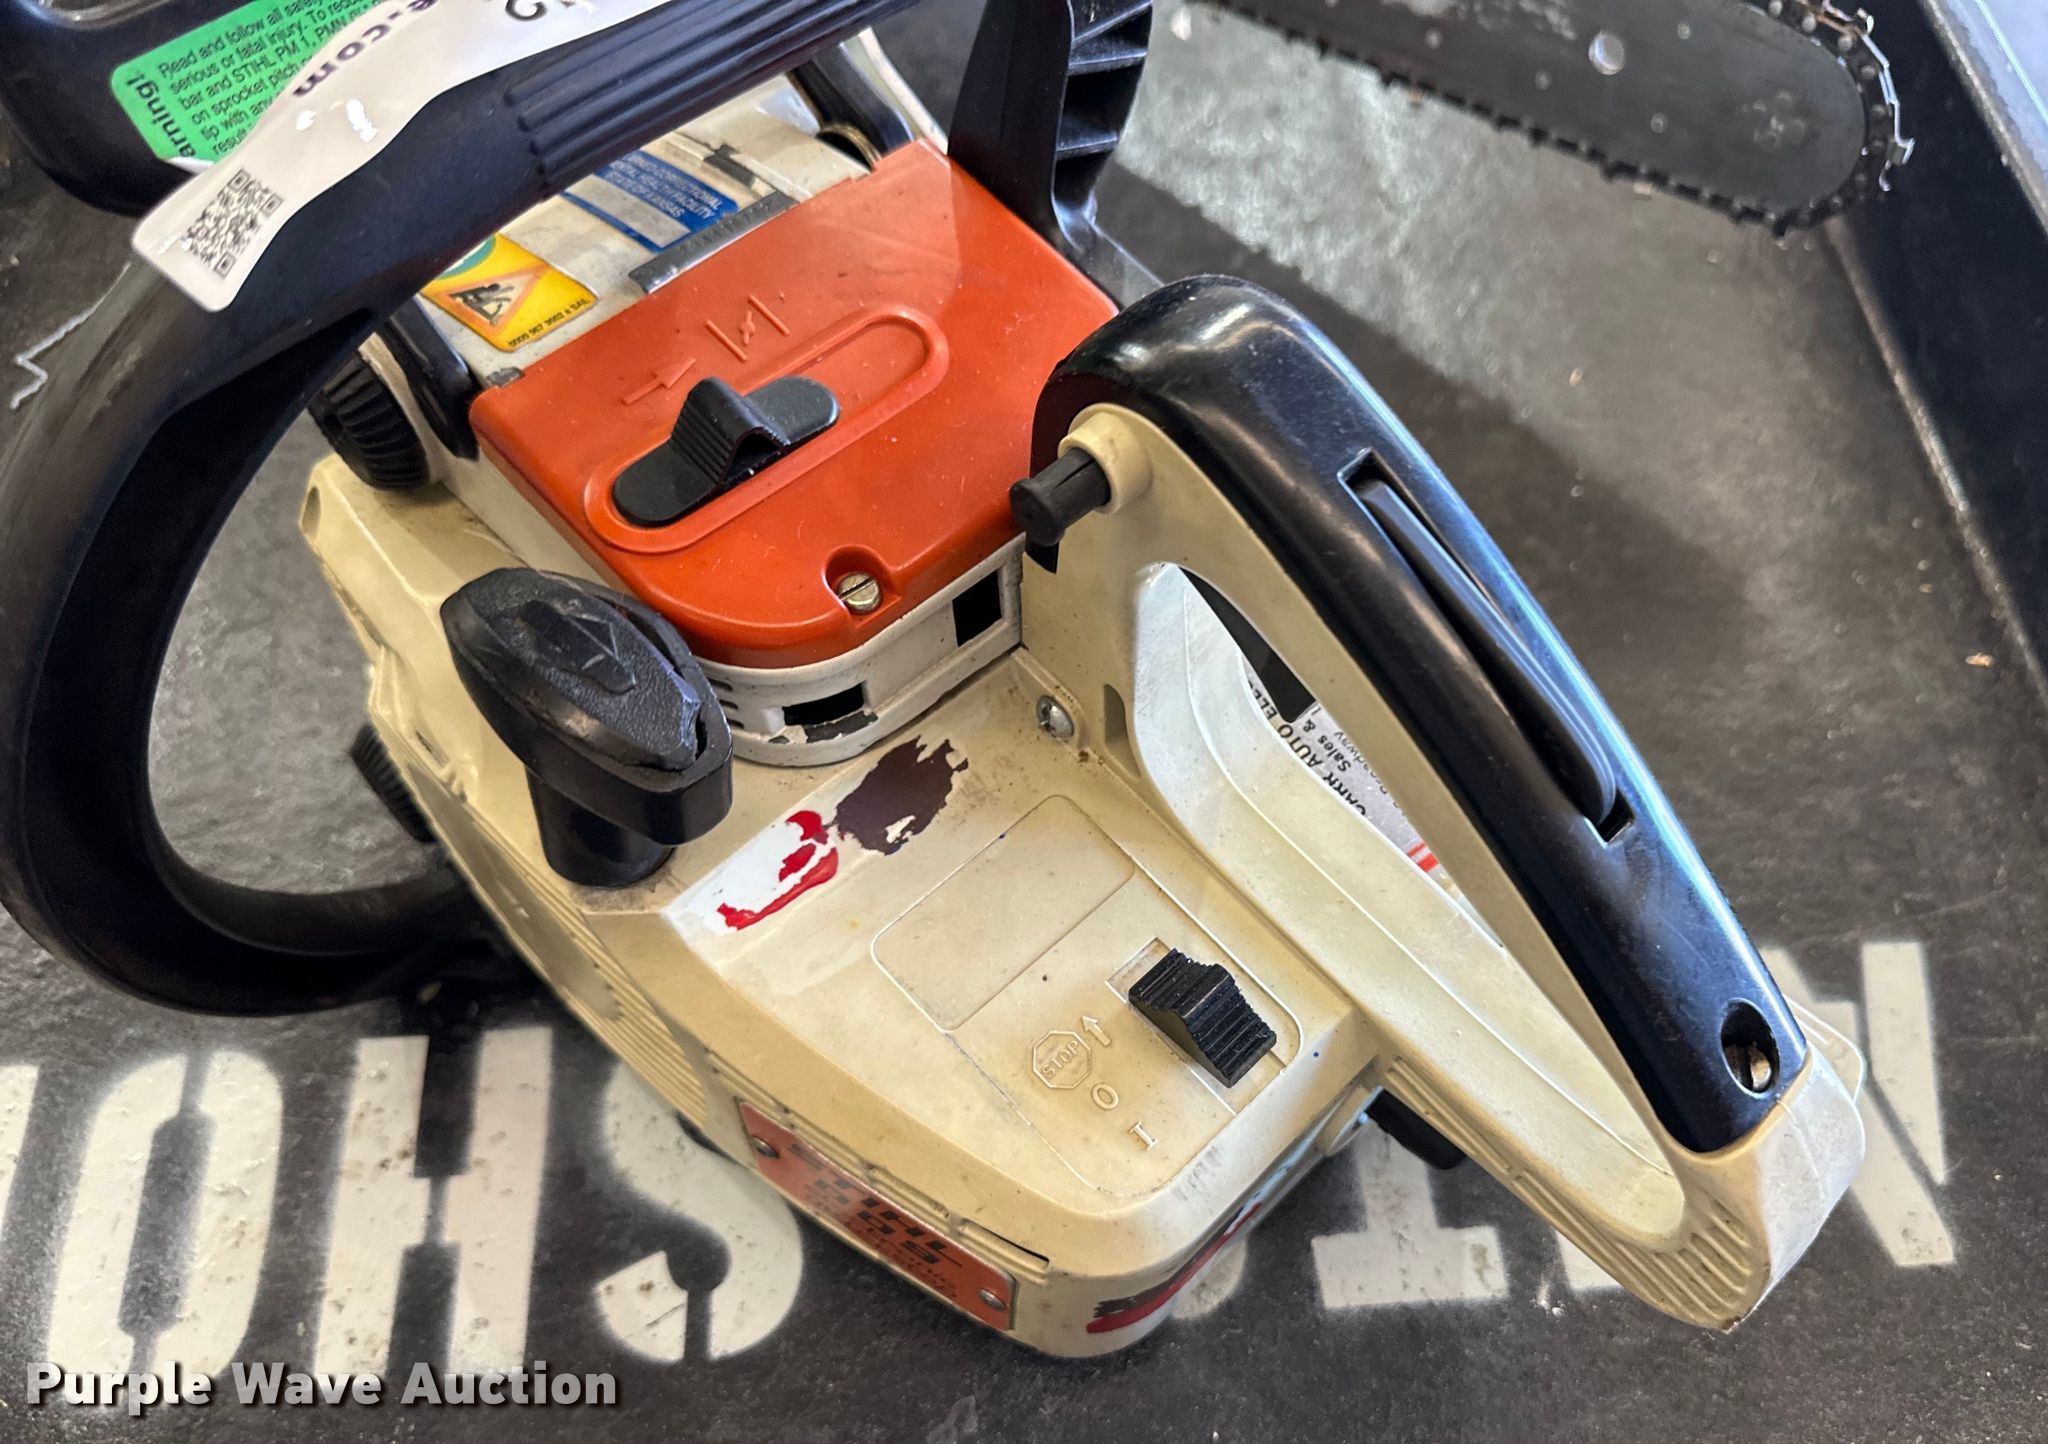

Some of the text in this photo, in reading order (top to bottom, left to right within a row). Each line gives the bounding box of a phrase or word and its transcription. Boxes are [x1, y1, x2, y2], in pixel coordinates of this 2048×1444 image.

[158, 50, 198, 79] Read
[200, 36, 226, 58] and
[225, 18, 265, 44] follow
[266, 7, 284, 27] all
[170, 62, 220, 95] serious
[221, 54, 235, 69] or
[305, 9, 327, 24] To
[179, 90, 204, 111] bar
[205, 74, 233, 98] and
[231, 54, 276, 84] STIHL
[275, 40, 300, 61] PM
[191, 109, 212, 126] on
[211, 77, 269, 115] sprocket
[126, 73, 197, 157] arning!
[220, 107, 250, 131] with
[1276, 721, 1323, 768] AUTO
[1301, 717, 1352, 773] Sales &
[1041, 1039, 1080, 1079] STOP
[791, 1143, 964, 1268] STIHL
